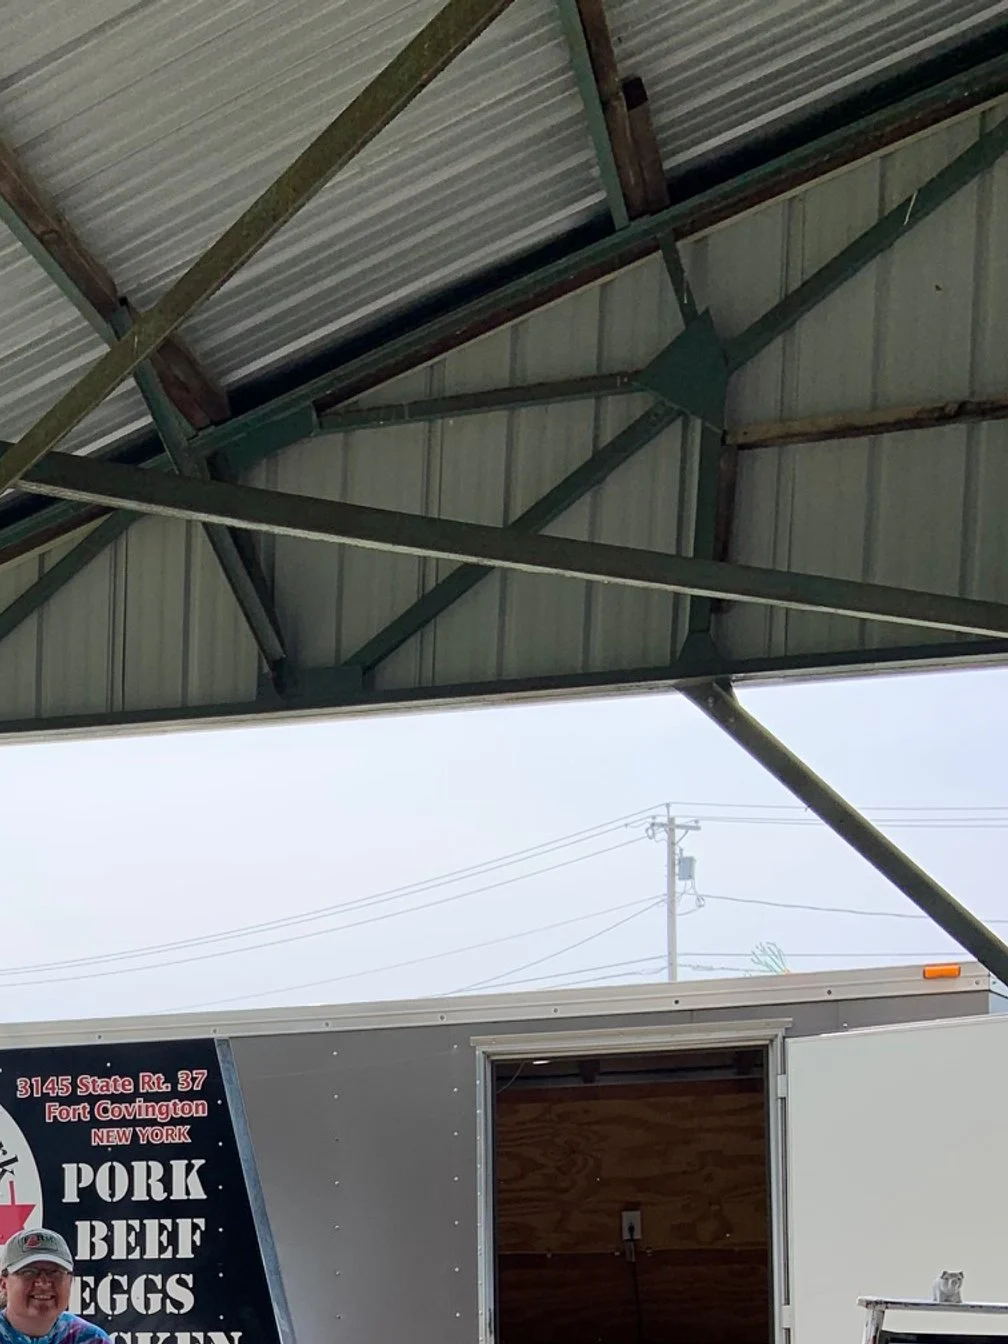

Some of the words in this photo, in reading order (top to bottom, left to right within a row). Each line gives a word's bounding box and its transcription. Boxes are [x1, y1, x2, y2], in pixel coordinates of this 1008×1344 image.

[16, 1075, 72, 1098] 3145
[77, 1075, 134, 1096] State
[139, 1072, 171, 1093] Rt.
[178, 1069, 208, 1091] 37
[46, 1102, 90, 1122] Fort
[95, 1098, 207, 1122] Covington
[91, 1127, 133, 1146] NEW
[135, 1125, 191, 1144] YORK
[61, 1159, 207, 1202] PORK
[75, 1218, 205, 1260] BEEF
[68, 1273, 194, 1315] EGGS
